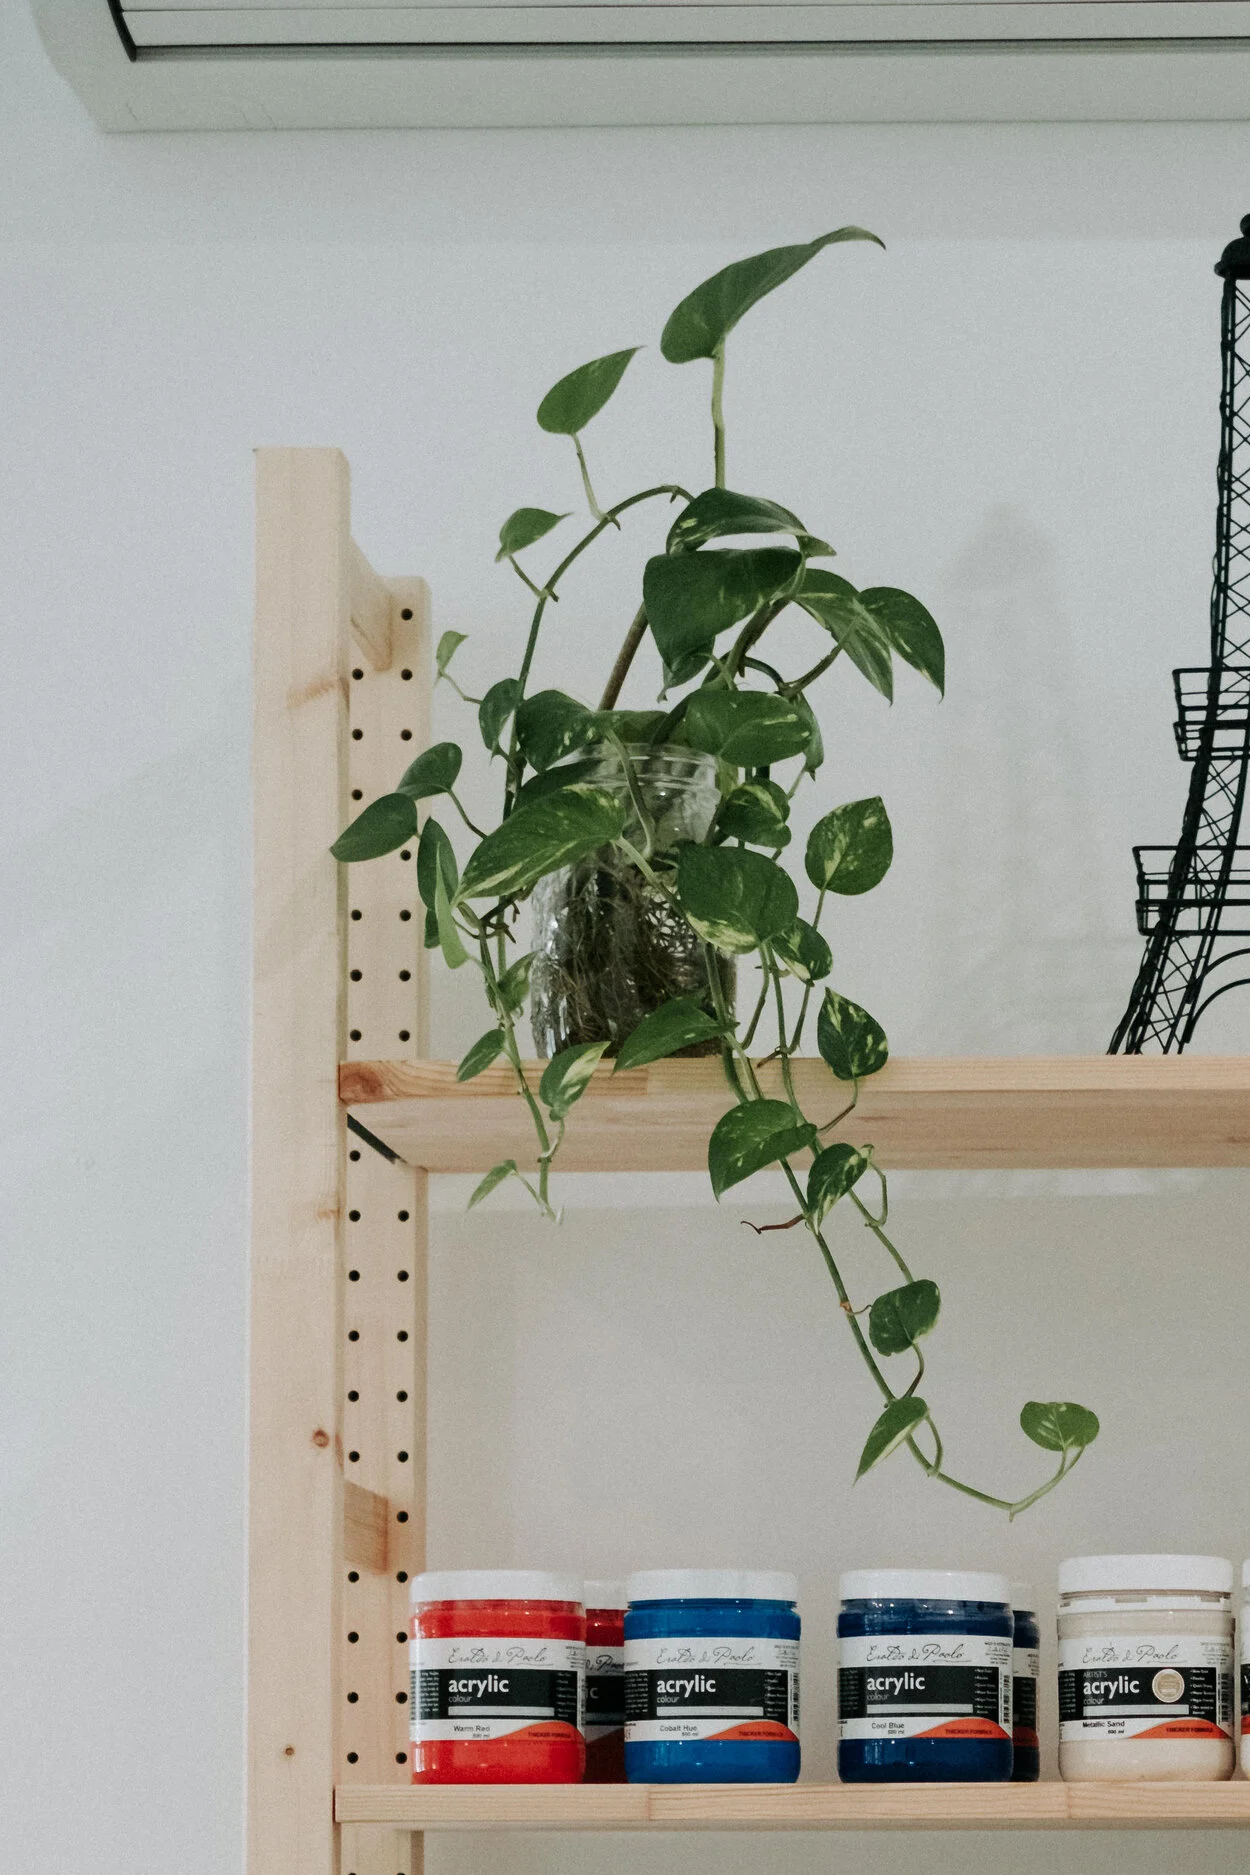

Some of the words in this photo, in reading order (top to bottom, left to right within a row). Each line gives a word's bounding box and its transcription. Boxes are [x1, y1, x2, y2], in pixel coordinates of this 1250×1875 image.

[448, 1674, 509, 1697] acrylic
[656, 1674, 717, 1698] acrylic
[866, 1672, 926, 1695] acrylic
[1083, 1676, 1140, 1699] acrylic
[656, 1695, 680, 1703] colour
[866, 1692, 890, 1701] colour
[1083, 1697, 1104, 1705] colour
